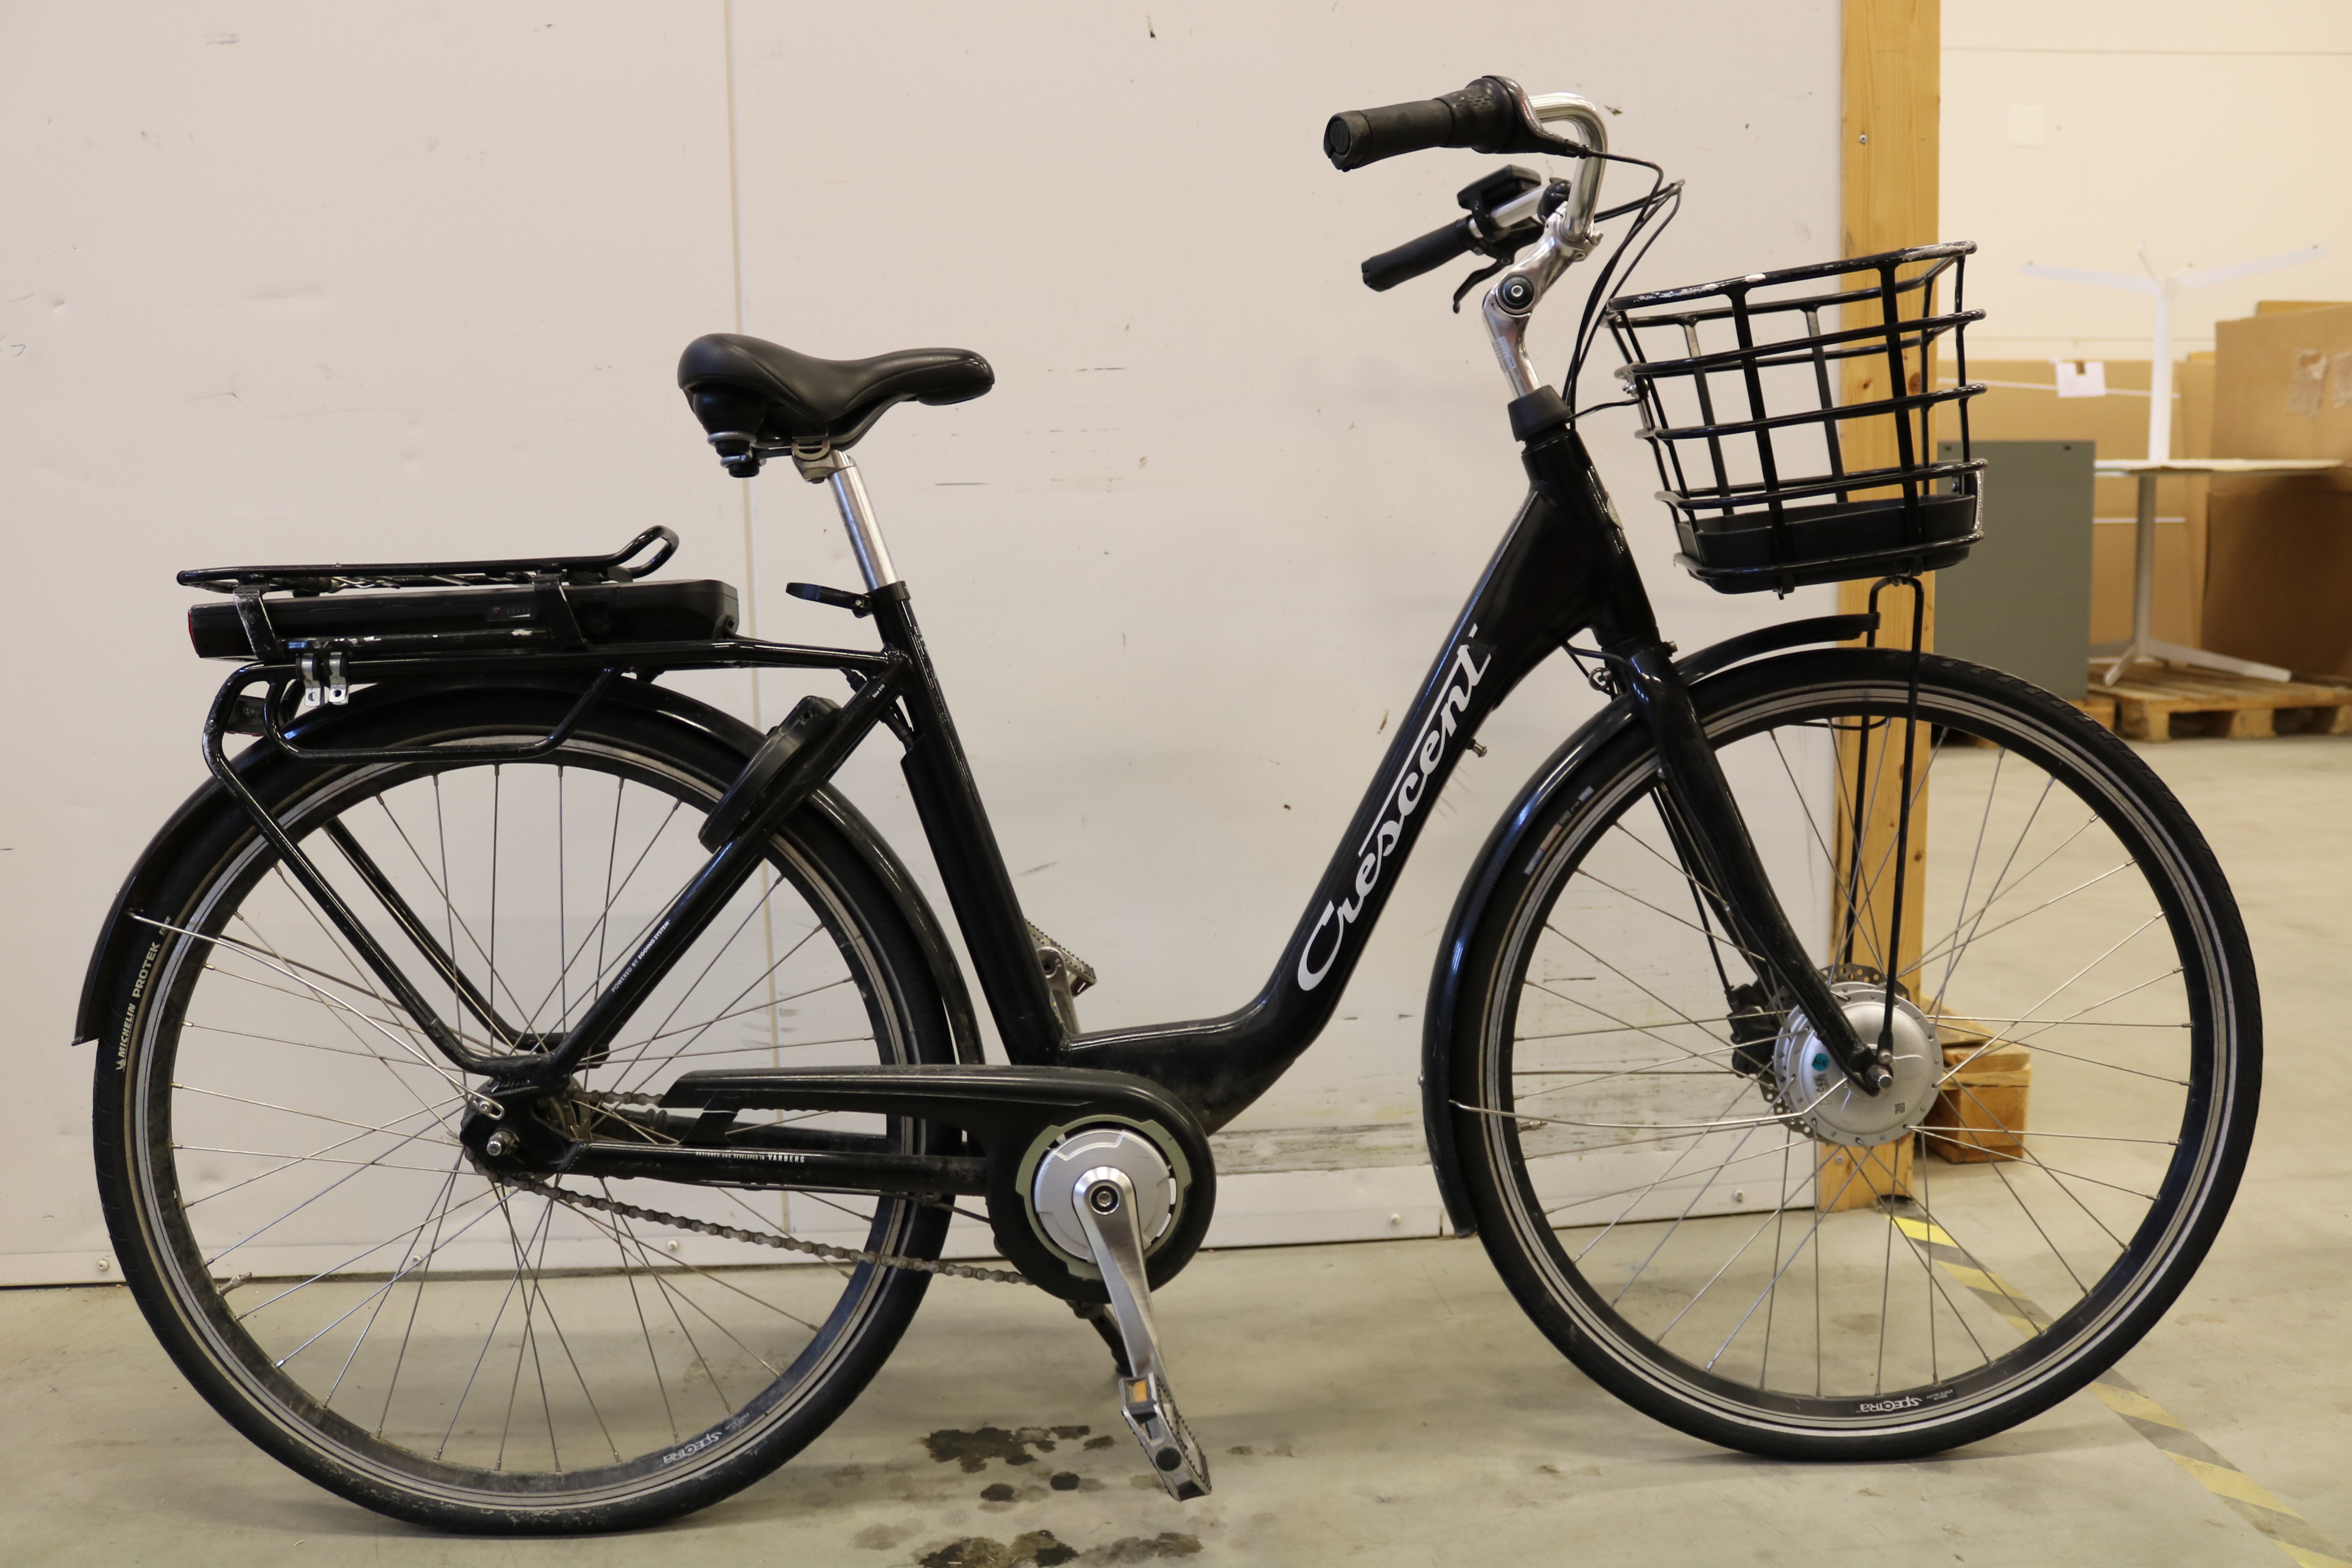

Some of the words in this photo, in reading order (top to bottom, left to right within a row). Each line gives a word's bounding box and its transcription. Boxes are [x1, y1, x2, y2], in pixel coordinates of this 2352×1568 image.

[1298, 623, 1491, 991] Crescent
[118, 1003, 136, 1059] MICHELIN
[132, 941, 161, 998] PROTEK
[611, 967, 632, 992] POWERED
[631, 959, 639, 968] BY
[638, 939, 655, 960] EGOING
[654, 920, 670, 940] SYSTEM
[767, 1154, 805, 1163] VARBERG
